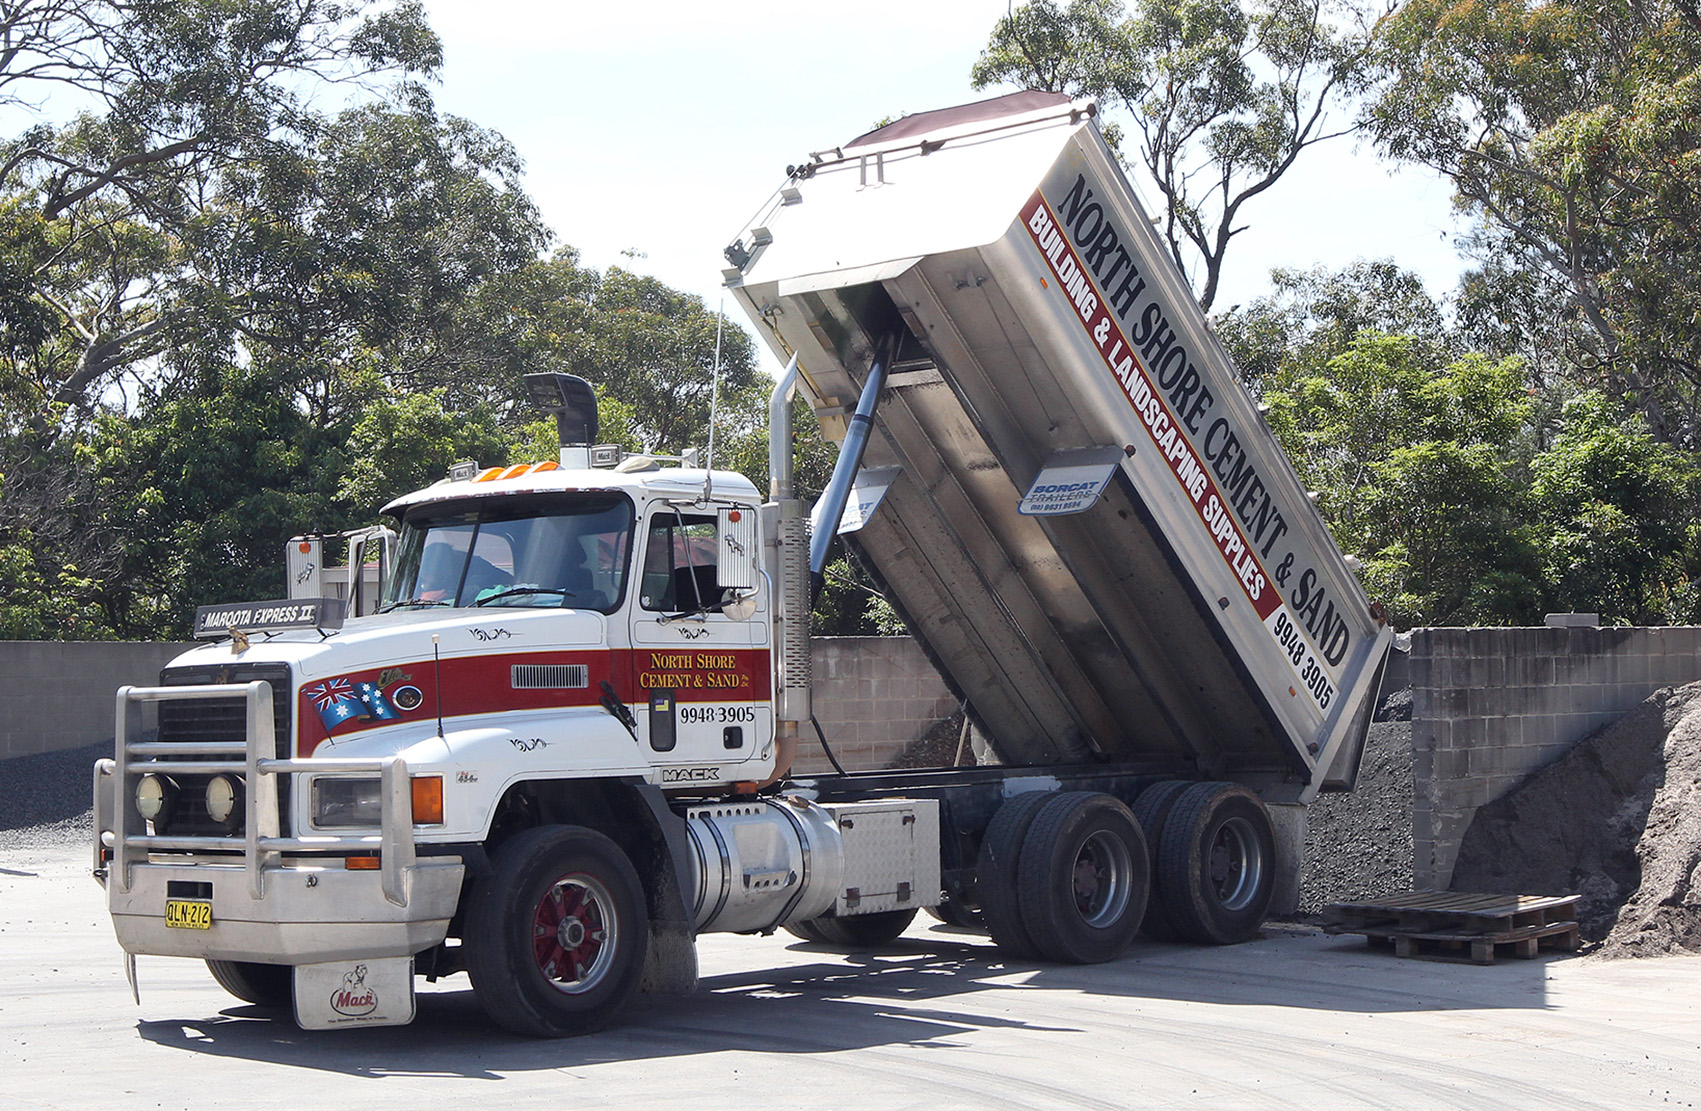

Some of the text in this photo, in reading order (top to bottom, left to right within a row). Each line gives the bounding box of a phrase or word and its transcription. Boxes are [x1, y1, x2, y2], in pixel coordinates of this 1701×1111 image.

[1028, 204, 1266, 601] BUILDING & LANDSCAPING SUPPLIES
[1057, 173, 1351, 668] NORTH SHORE CEMENT & SAND
[1033, 481, 1099, 494] BORCAT
[1272, 612, 1334, 710] 9948 3905
[693, 674, 704, 688] &
[662, 767, 720, 782] MACK
[336, 991, 375, 1008] Mack
